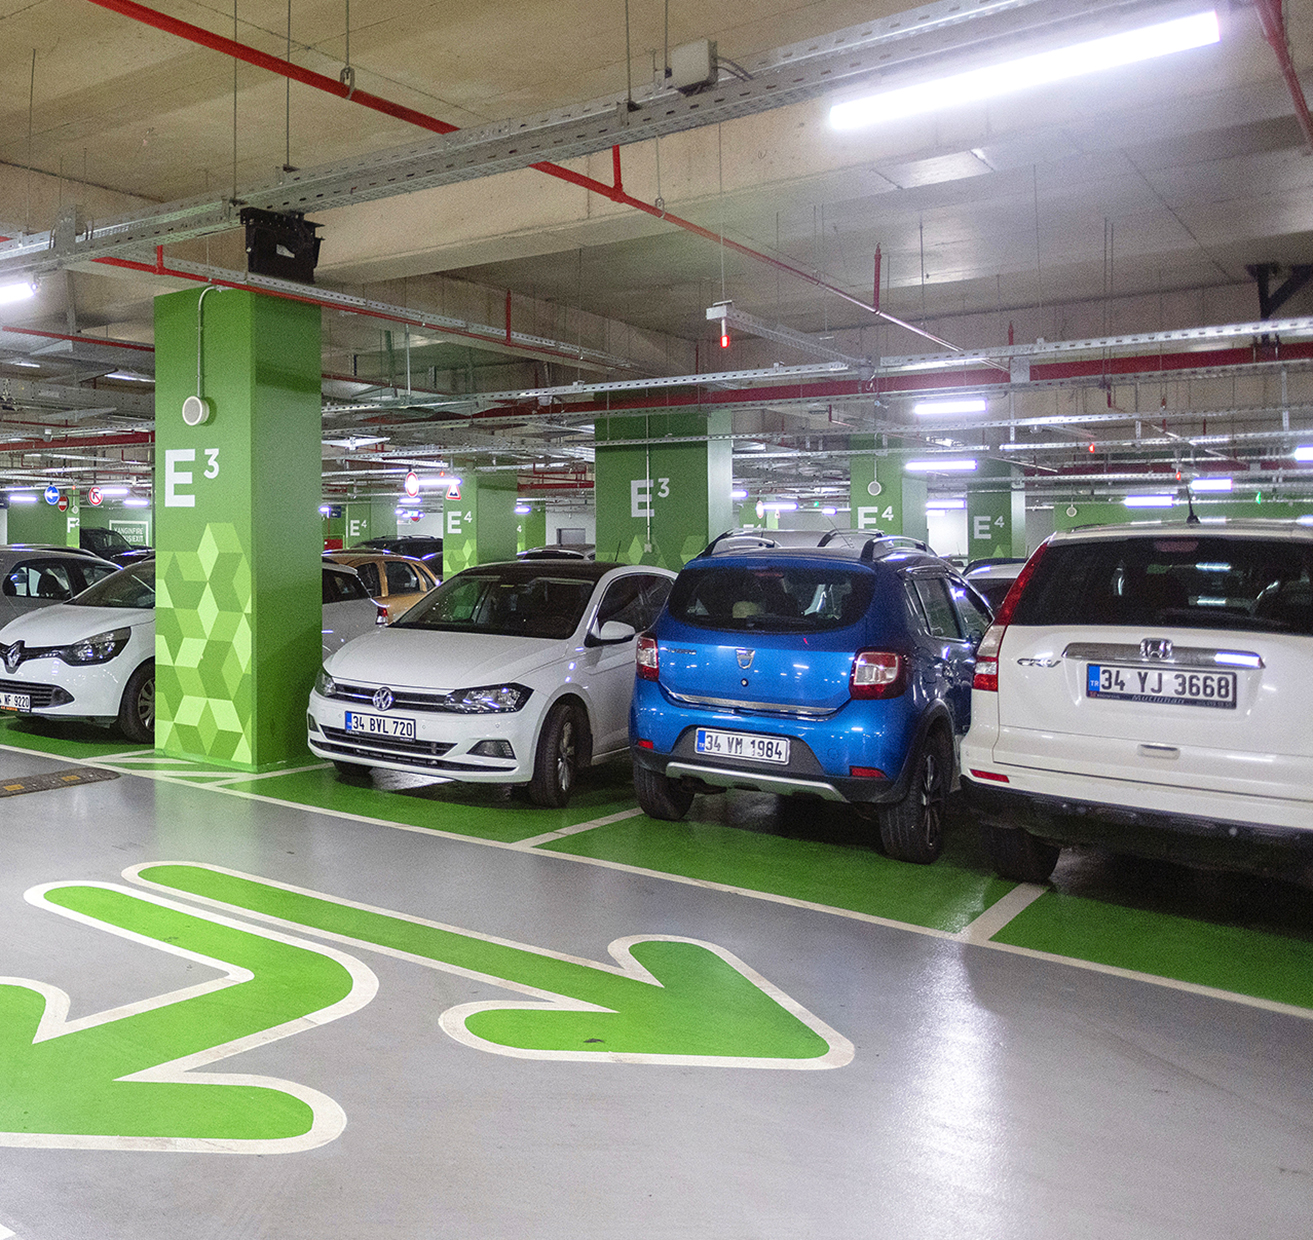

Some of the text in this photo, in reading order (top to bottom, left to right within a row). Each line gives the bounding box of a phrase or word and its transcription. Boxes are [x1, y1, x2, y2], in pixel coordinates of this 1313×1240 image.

[1101, 669, 1230, 699] 34 YJ 3668
[353, 715, 413, 737] 34 BVL 720
[705, 734, 782, 759] 34 VM 1984
